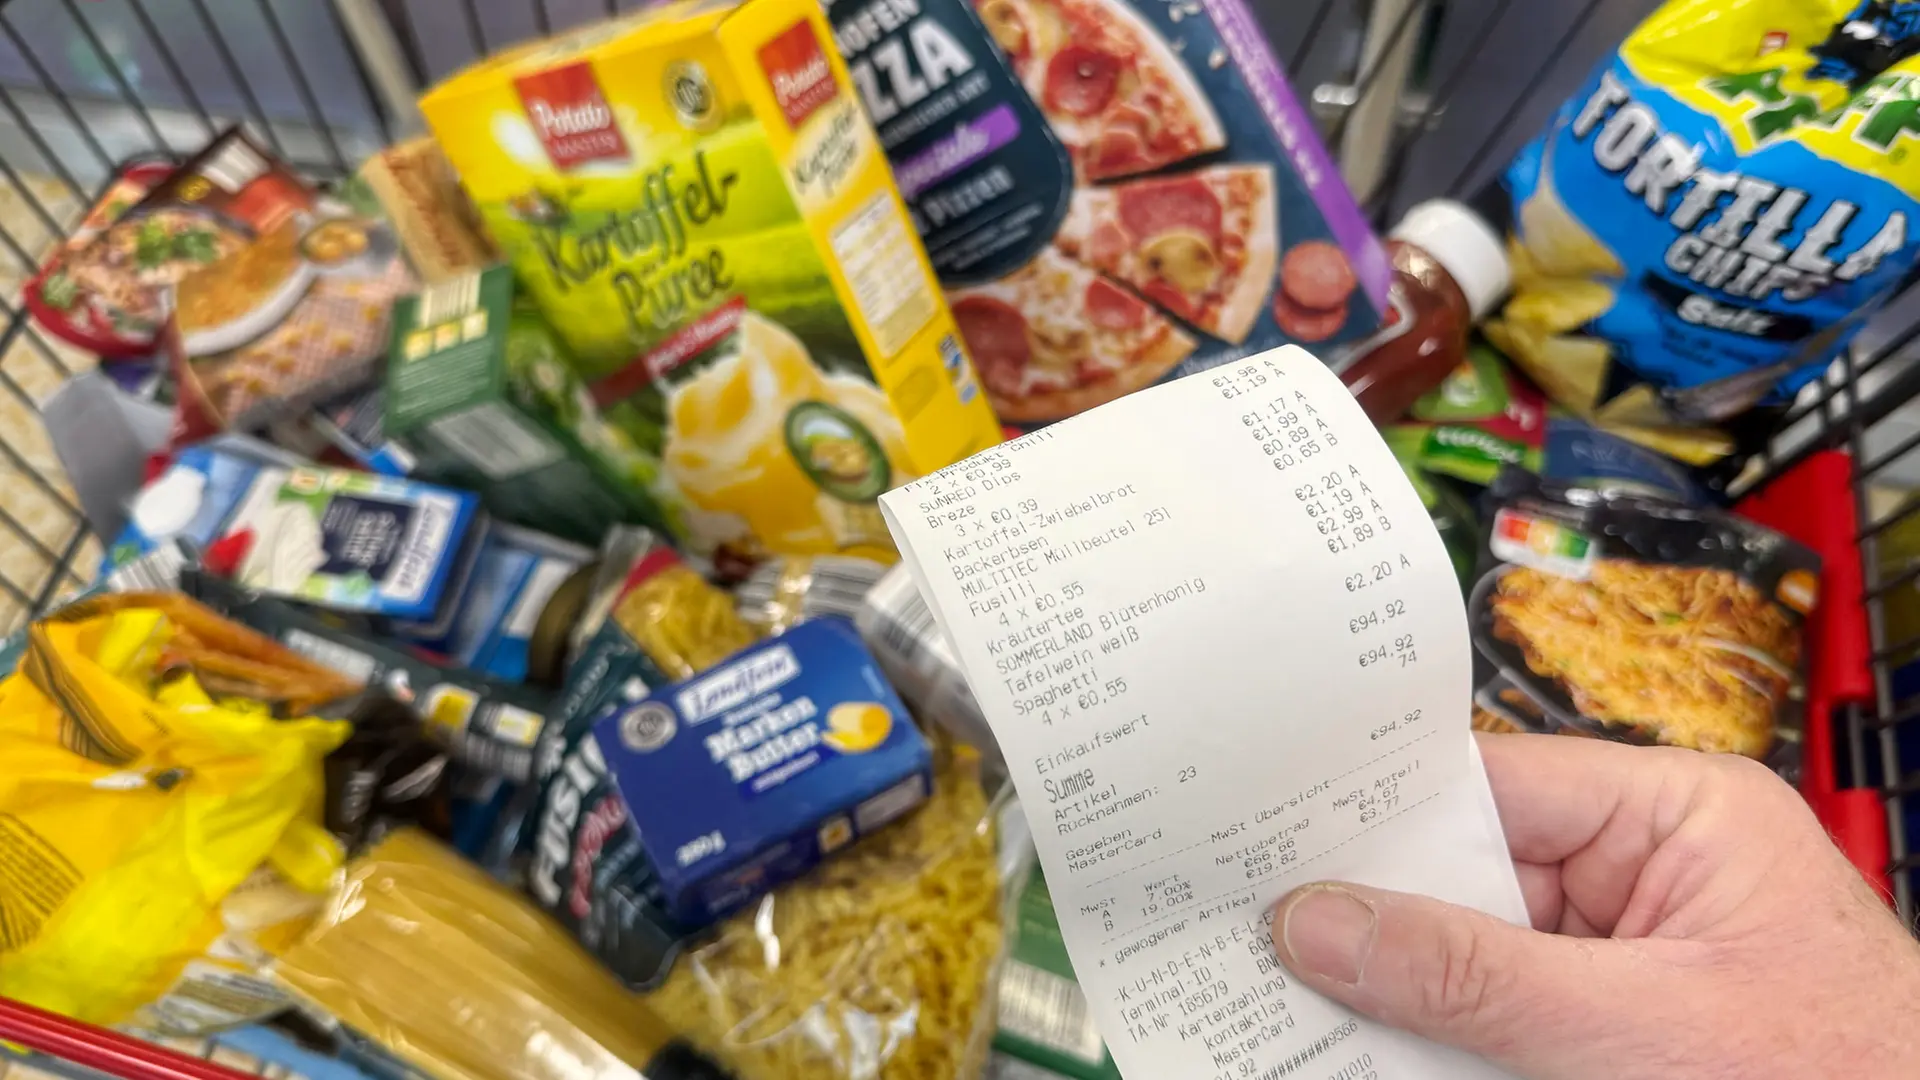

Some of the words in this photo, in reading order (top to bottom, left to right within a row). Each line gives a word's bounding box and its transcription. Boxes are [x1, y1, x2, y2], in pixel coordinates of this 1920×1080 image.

[531, 95, 611, 138] Potato
[613, 248, 735, 344] Püree
[1264, 360, 1275, 368] A
[919, 485, 977, 514] SUNRED
[982, 471, 1021, 492] Dips
[1274, 368, 1286, 379] A
[926, 505, 976, 529] Breze
[1241, 397, 1287, 427] €1,17
[1294, 390, 1307, 403] A
[929, 485, 942, 495] 2
[965, 458, 1012, 482] €0,99
[943, 483, 1137, 563] Kartoffel-Zwiebelbrot
[1252, 411, 1298, 442] €1,99
[1304, 403, 1318, 416] A
[951, 535, 1049, 581] Backerbsen
[1262, 426, 1309, 456] €0,89
[1315, 417, 1329, 431] A
[954, 524, 966, 537] 3
[990, 498, 1038, 524] €0,39
[960, 558, 1038, 600] MULTITEC
[1044, 519, 1136, 565] Müllbeutel
[1272, 439, 1321, 470] €0,65
[1325, 432, 1338, 447] B
[969, 579, 1037, 617] Fusilli
[1294, 471, 1342, 501] €2,20
[1348, 464, 1361, 478] A
[986, 606, 1085, 657] Kräutertee
[1305, 488, 1353, 518] €1,19
[1359, 480, 1373, 496] A
[996, 622, 1093, 676] SOMMERLAND
[1098, 576, 1206, 632] Blütenhonig
[1316, 505, 1364, 535] €2,99
[1370, 497, 1383, 513] A
[999, 612, 1011, 627] 4
[1034, 581, 1085, 612] €0,55
[1004, 649, 1094, 696] Tafelwein
[1327, 523, 1374, 553] €1,89
[1013, 666, 1099, 716] Spaghetti
[1345, 561, 1392, 592] €2,20
[1399, 553, 1411, 569] A
[1034, 713, 1150, 775] Einkaufswert
[1349, 599, 1406, 634] €94,92
[1041, 709, 1053, 726] 4
[1077, 677, 1128, 710] €0,55
[704, 695, 818, 763] Marken
[727, 721, 820, 783] Butter
[1054, 783, 1118, 823] Artikel
[1397, 649, 1418, 668] 74
[1043, 767, 1096, 804] Summe
[1176, 765, 1198, 783] 23
[1065, 828, 1133, 862] Gegeben
[1068, 828, 1163, 874] MasterCard
[1080, 897, 1116, 916] MwSt
[1143, 873, 1180, 893] Wert
[1215, 818, 1310, 867] Nettobetrag
[1332, 787, 1365, 811] MwSt
[1373, 759, 1420, 790] Anteil
[1101, 909, 1112, 920] A
[1104, 919, 1115, 932] B
[1114, 918, 1190, 965] gewogener
[1198, 892, 1258, 922] Artikel
[1127, 1013, 1171, 1044] TA-Nr
[1177, 979, 1230, 1017] 185679
[1177, 975, 1287, 1041] Kartenzahlung
[1202, 997, 1287, 1051] kontaktlos
[1212, 1013, 1295, 1070] MasterCard
